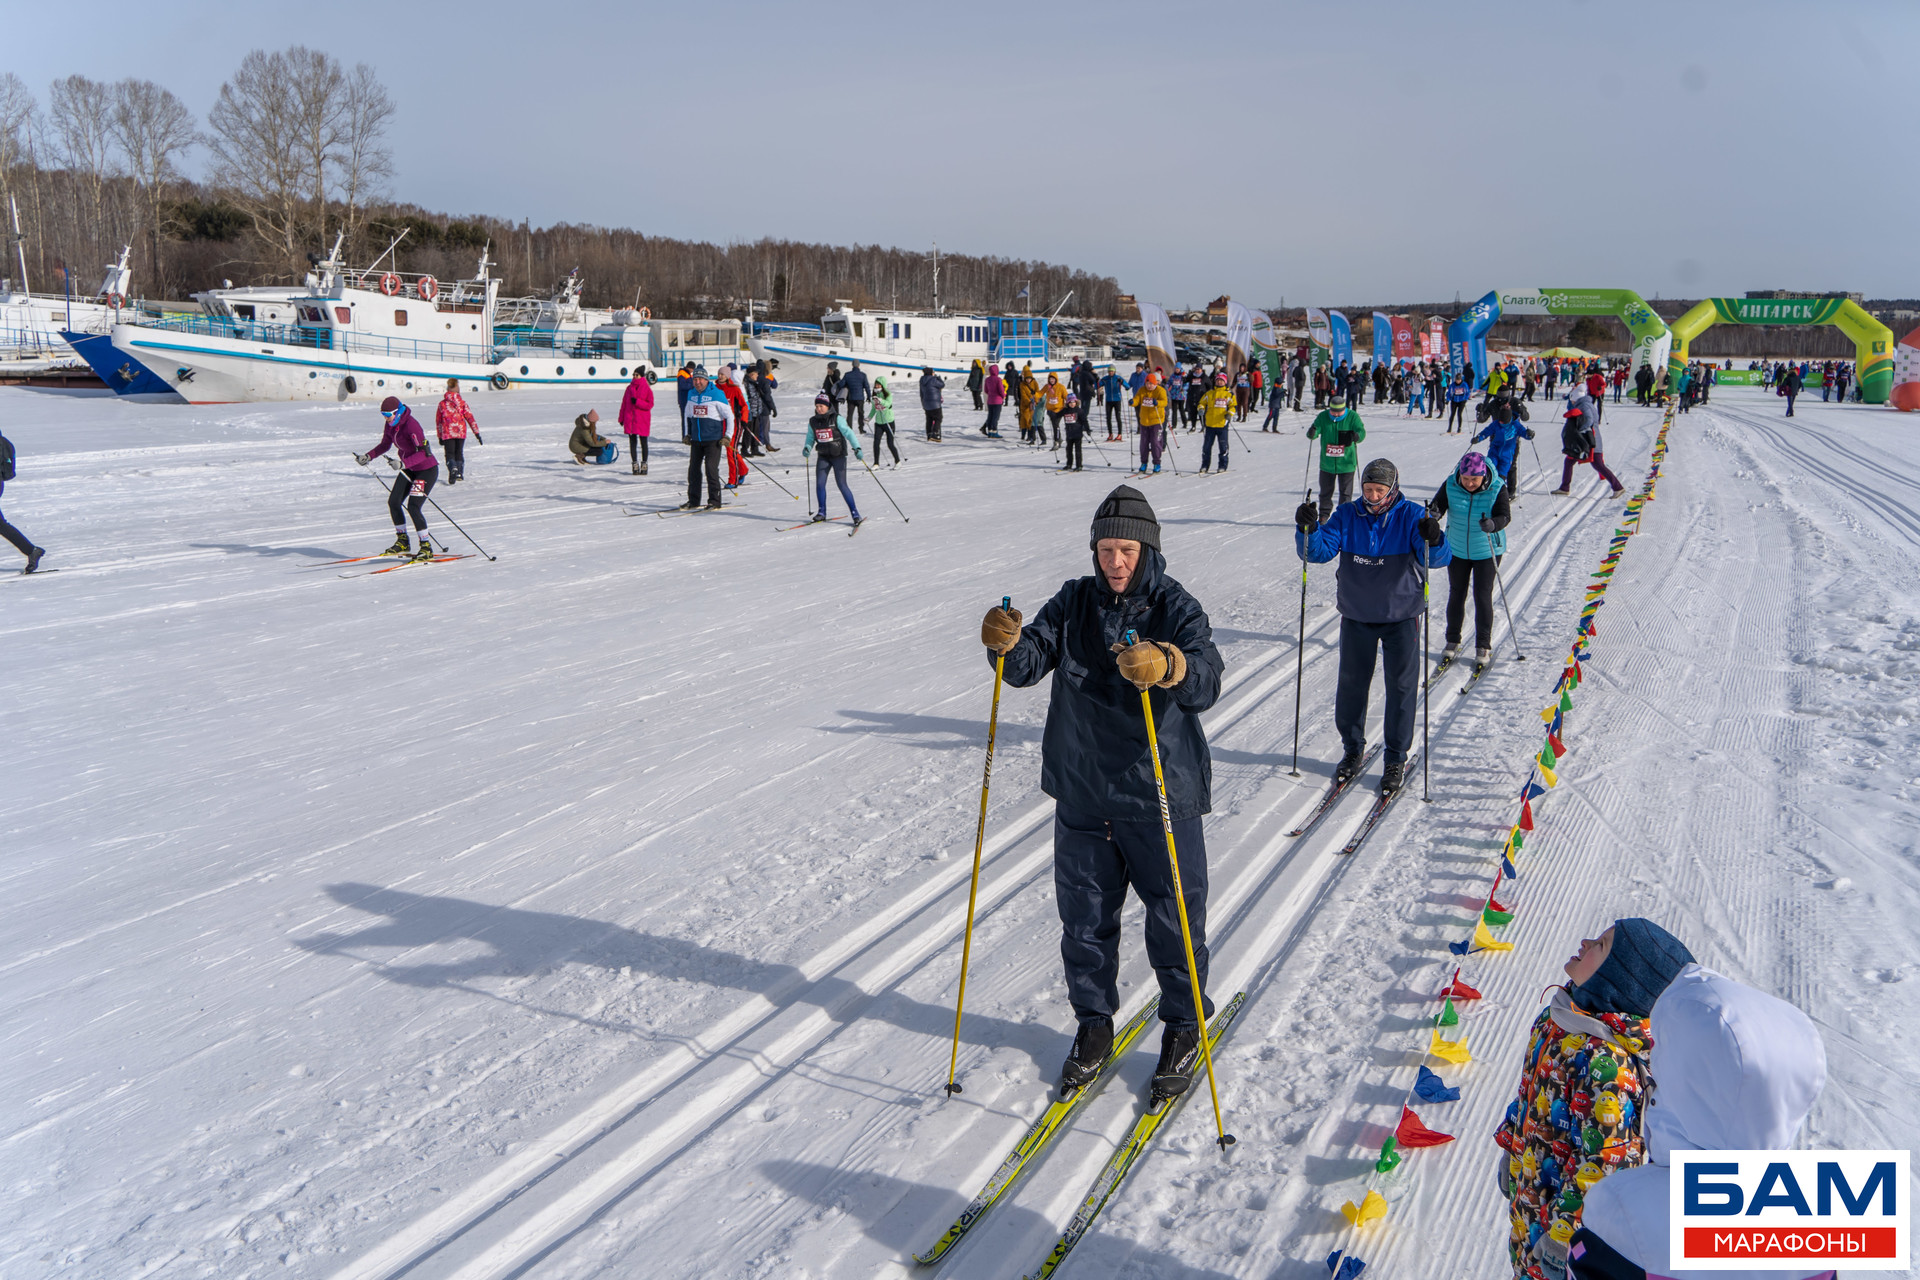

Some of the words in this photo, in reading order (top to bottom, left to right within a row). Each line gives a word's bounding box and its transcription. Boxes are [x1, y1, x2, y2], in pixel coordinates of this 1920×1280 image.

[1502, 295, 1536, 305] Слата
[1738, 304, 1813, 319] АНГАРСК
[1641, 349, 1651, 365] ата
[1175, 1041, 1199, 1073] FISCH
